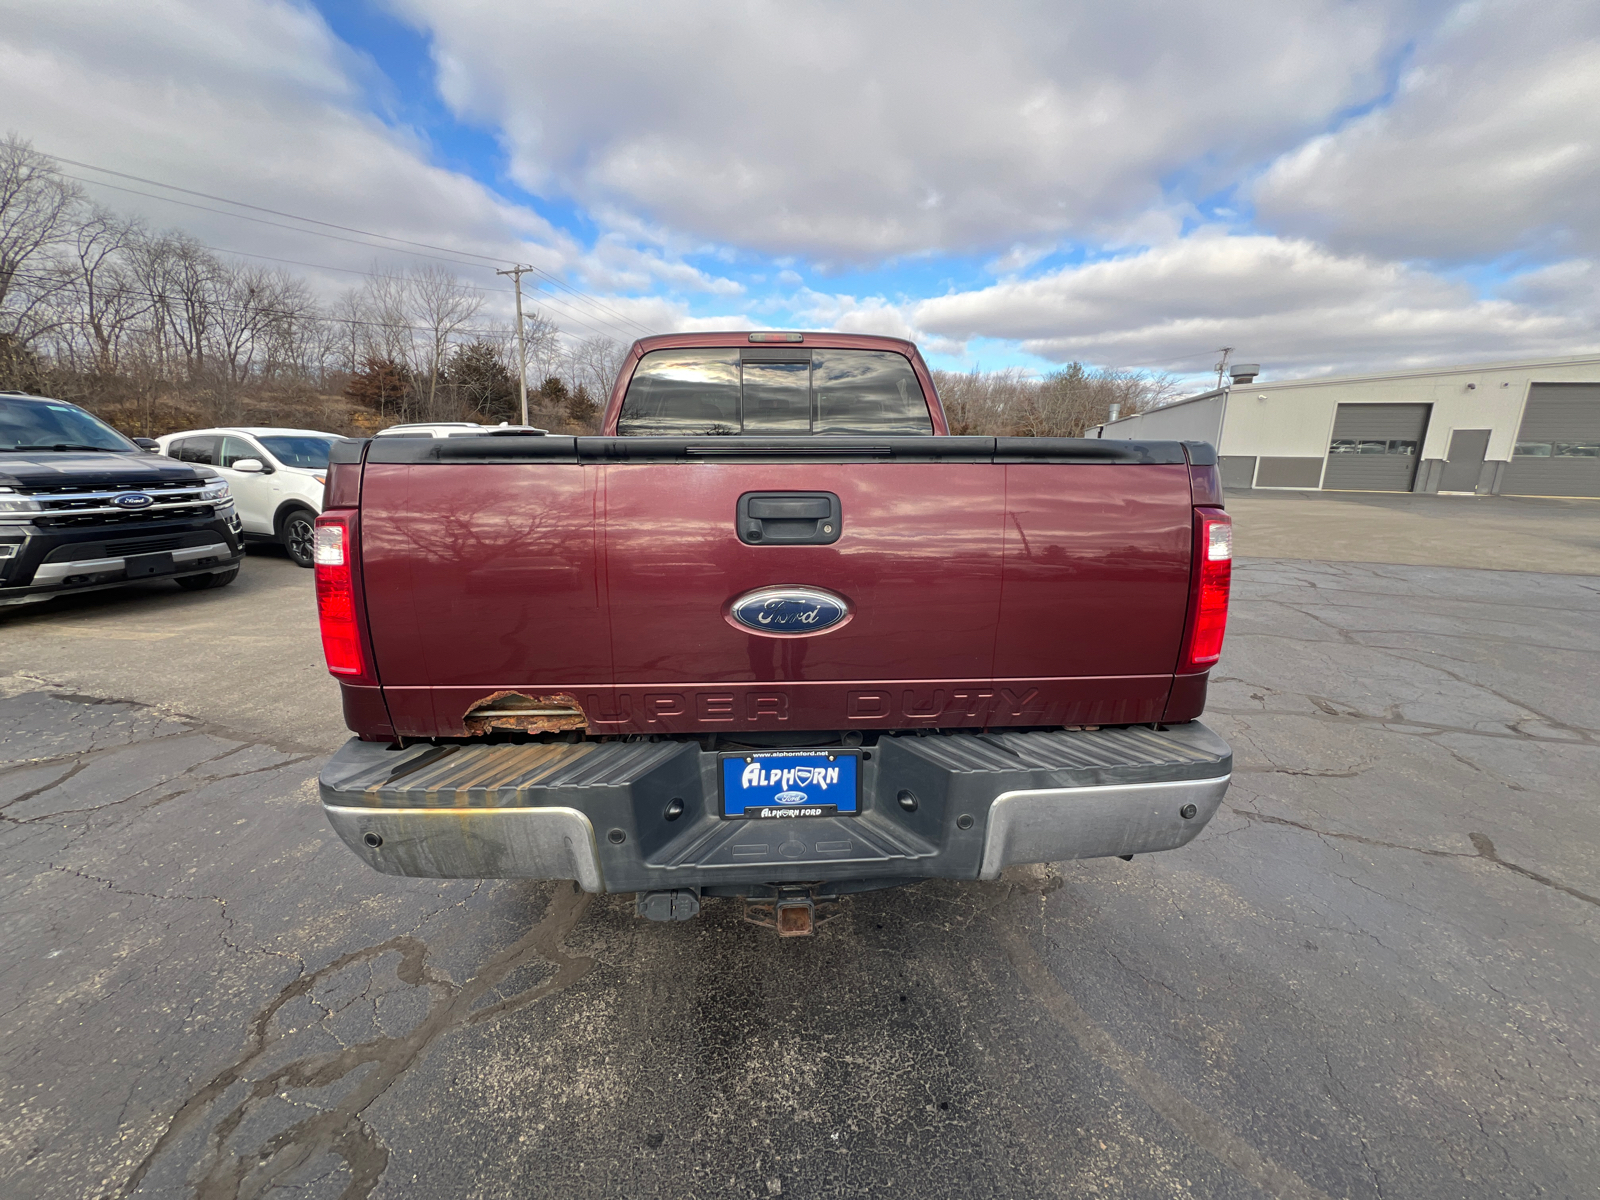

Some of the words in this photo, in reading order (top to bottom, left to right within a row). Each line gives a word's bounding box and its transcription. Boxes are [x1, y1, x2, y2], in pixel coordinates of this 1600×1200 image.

[758, 598, 821, 624] Ford
[586, 692, 789, 723] UPER
[847, 687, 1039, 719] DUTY
[781, 793, 801, 802] Ford
[800, 808, 822, 816] FORD
